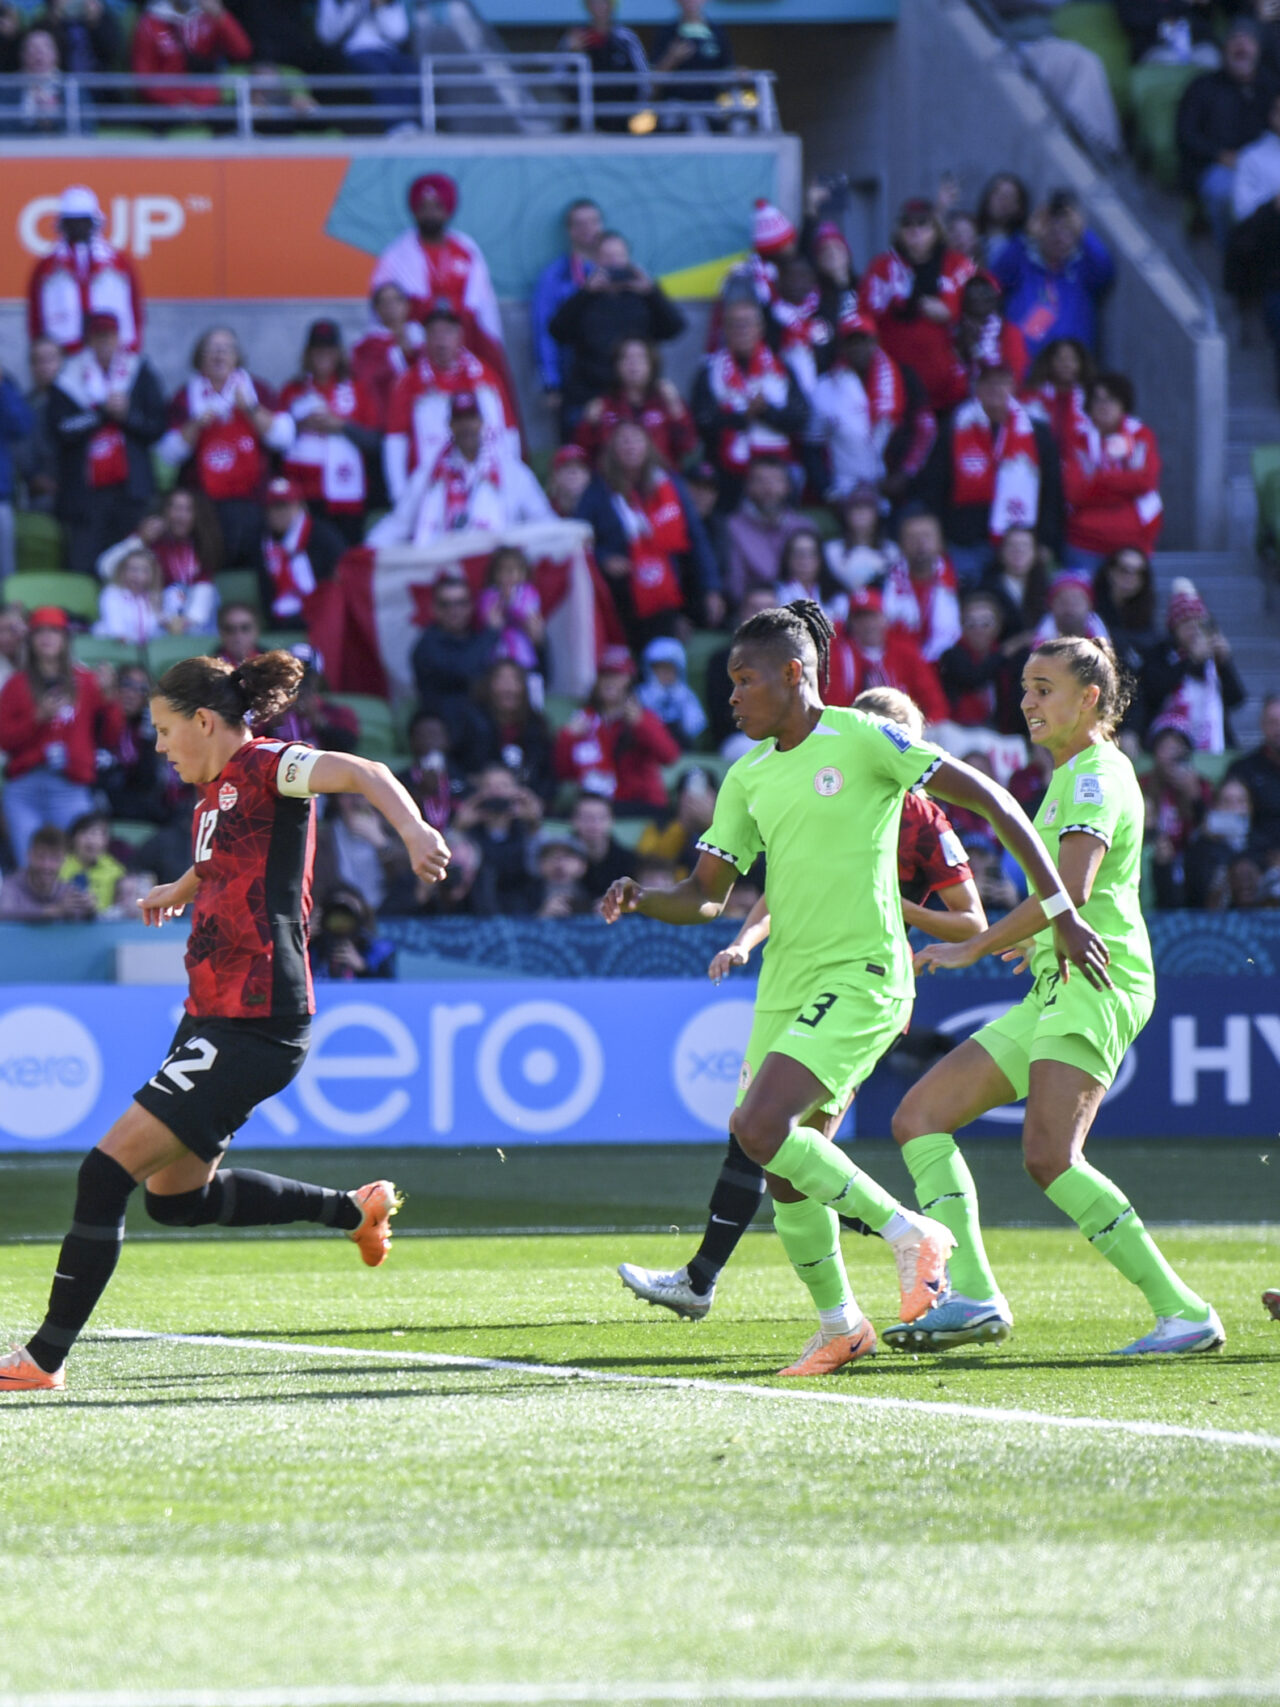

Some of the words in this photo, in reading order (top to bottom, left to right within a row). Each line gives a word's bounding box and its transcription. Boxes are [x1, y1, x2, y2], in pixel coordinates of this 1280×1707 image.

[195, 809, 219, 863] 12
[795, 992, 839, 1028] 3
[160, 1036, 218, 1092] 2
[255, 1001, 605, 1135] ero
